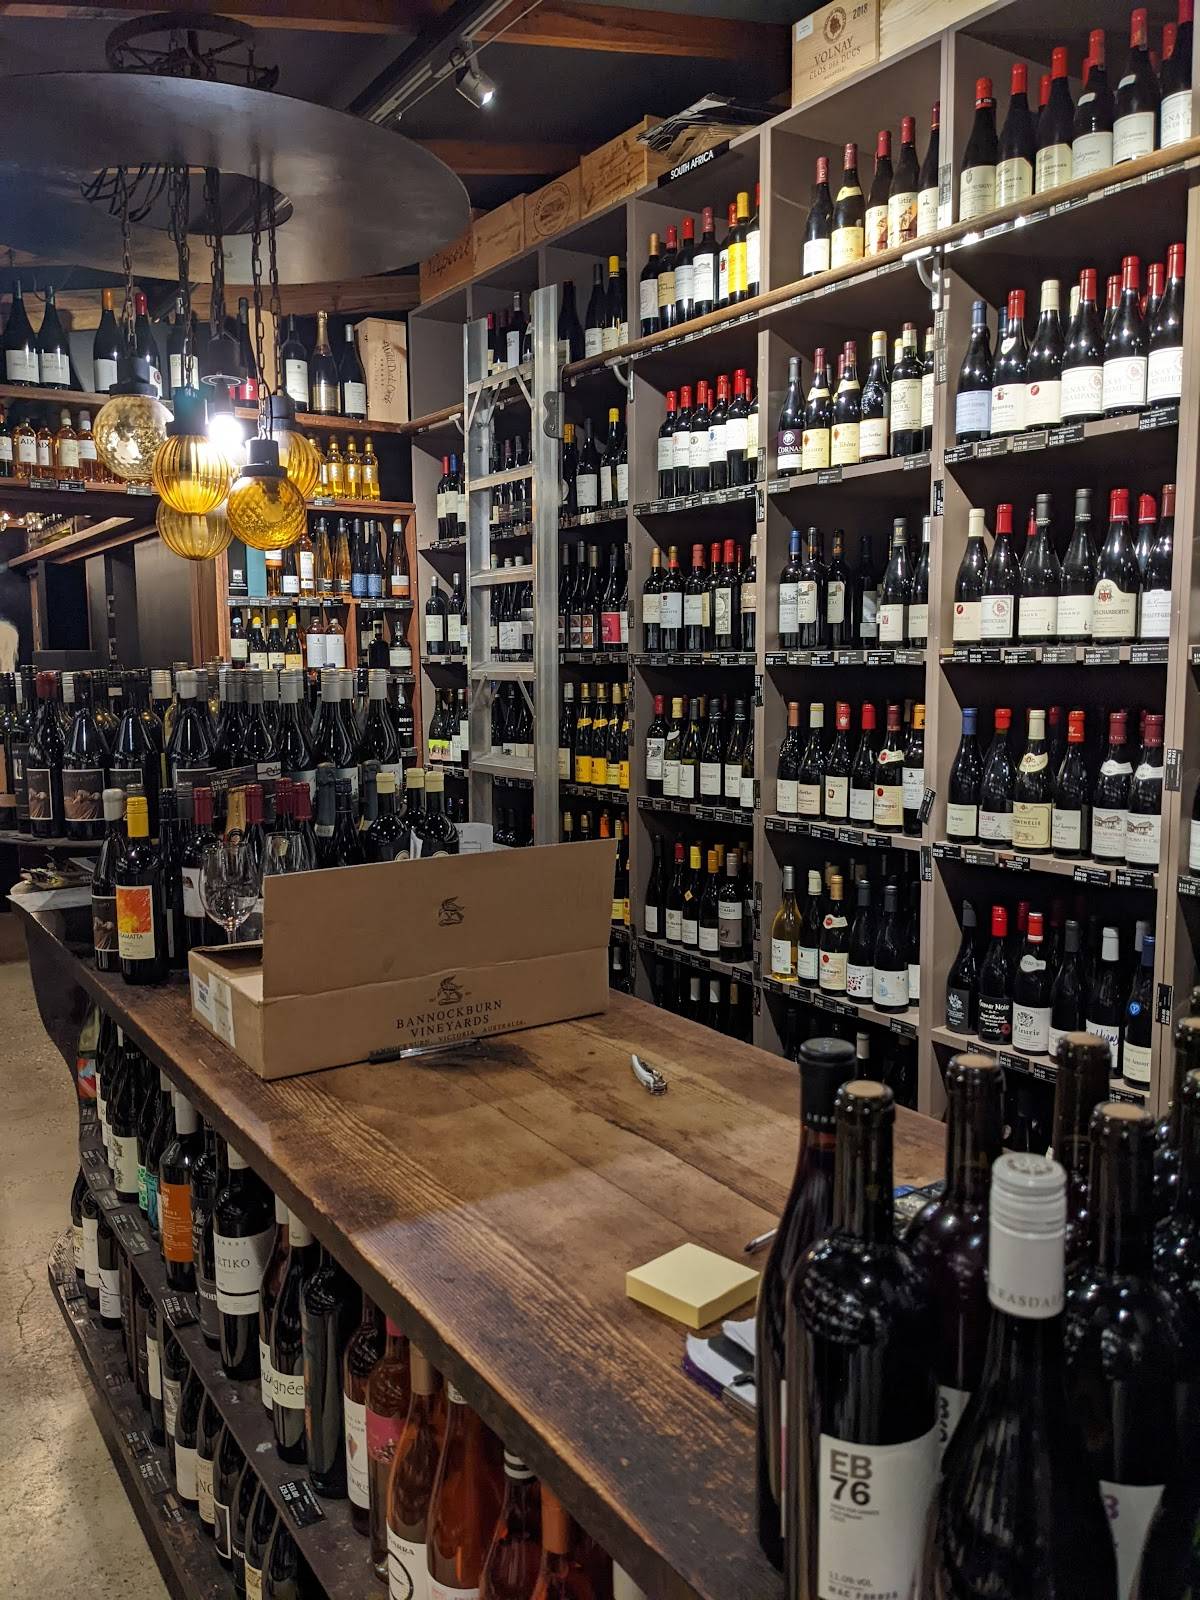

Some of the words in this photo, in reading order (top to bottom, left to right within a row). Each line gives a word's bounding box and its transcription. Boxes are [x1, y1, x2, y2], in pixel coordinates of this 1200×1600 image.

[813, 35, 853, 65] VOLNAY
[670, 161, 690, 180] SOUTH
[690, 150, 714, 170] AFRICA
[20, 438, 35, 446] AIX
[396, 1000, 503, 1029] BANNOCKBURN
[411, 1014, 489, 1038] VINEYARDS
[830, 1448, 873, 1480] EB
[830, 1474, 872, 1506] 76
